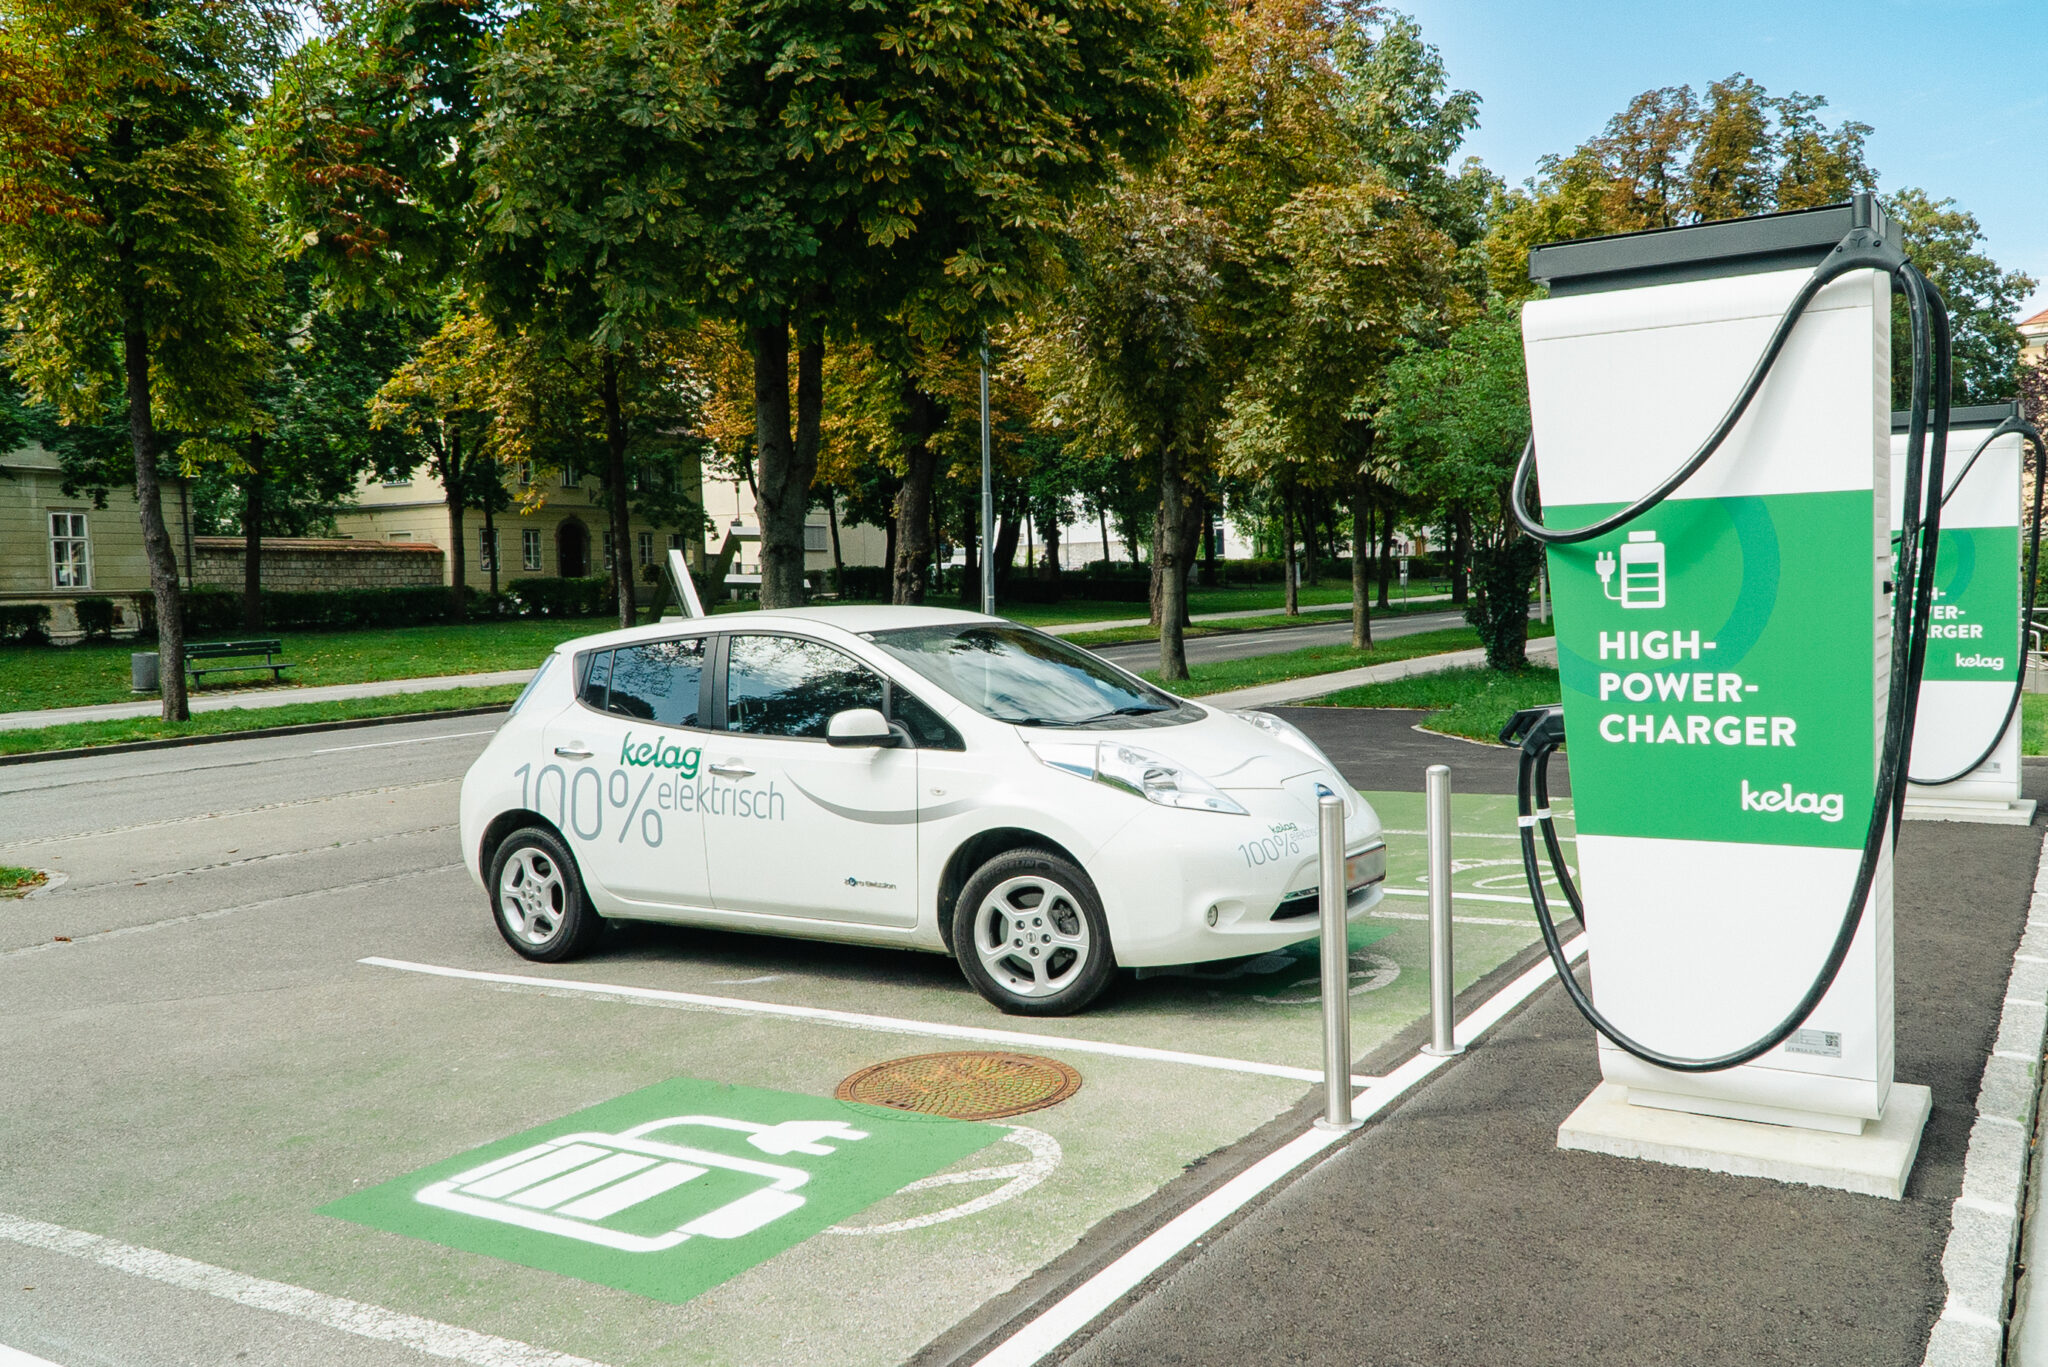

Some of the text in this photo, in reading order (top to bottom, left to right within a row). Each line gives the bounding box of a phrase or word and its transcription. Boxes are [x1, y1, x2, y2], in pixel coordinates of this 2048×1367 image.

[1600, 630, 1717, 660] HIGH-
[1955, 652, 2005, 671] kelag
[1600, 672, 1759, 702] POWER-
[1600, 714, 1797, 747] CHARGER
[620, 731, 703, 780] kelag
[514, 763, 784, 848] 100% elektrisch
[1741, 780, 1844, 822] kelag
[1268, 822, 1298, 834] kelag
[1238, 833, 1300, 868] 100%
